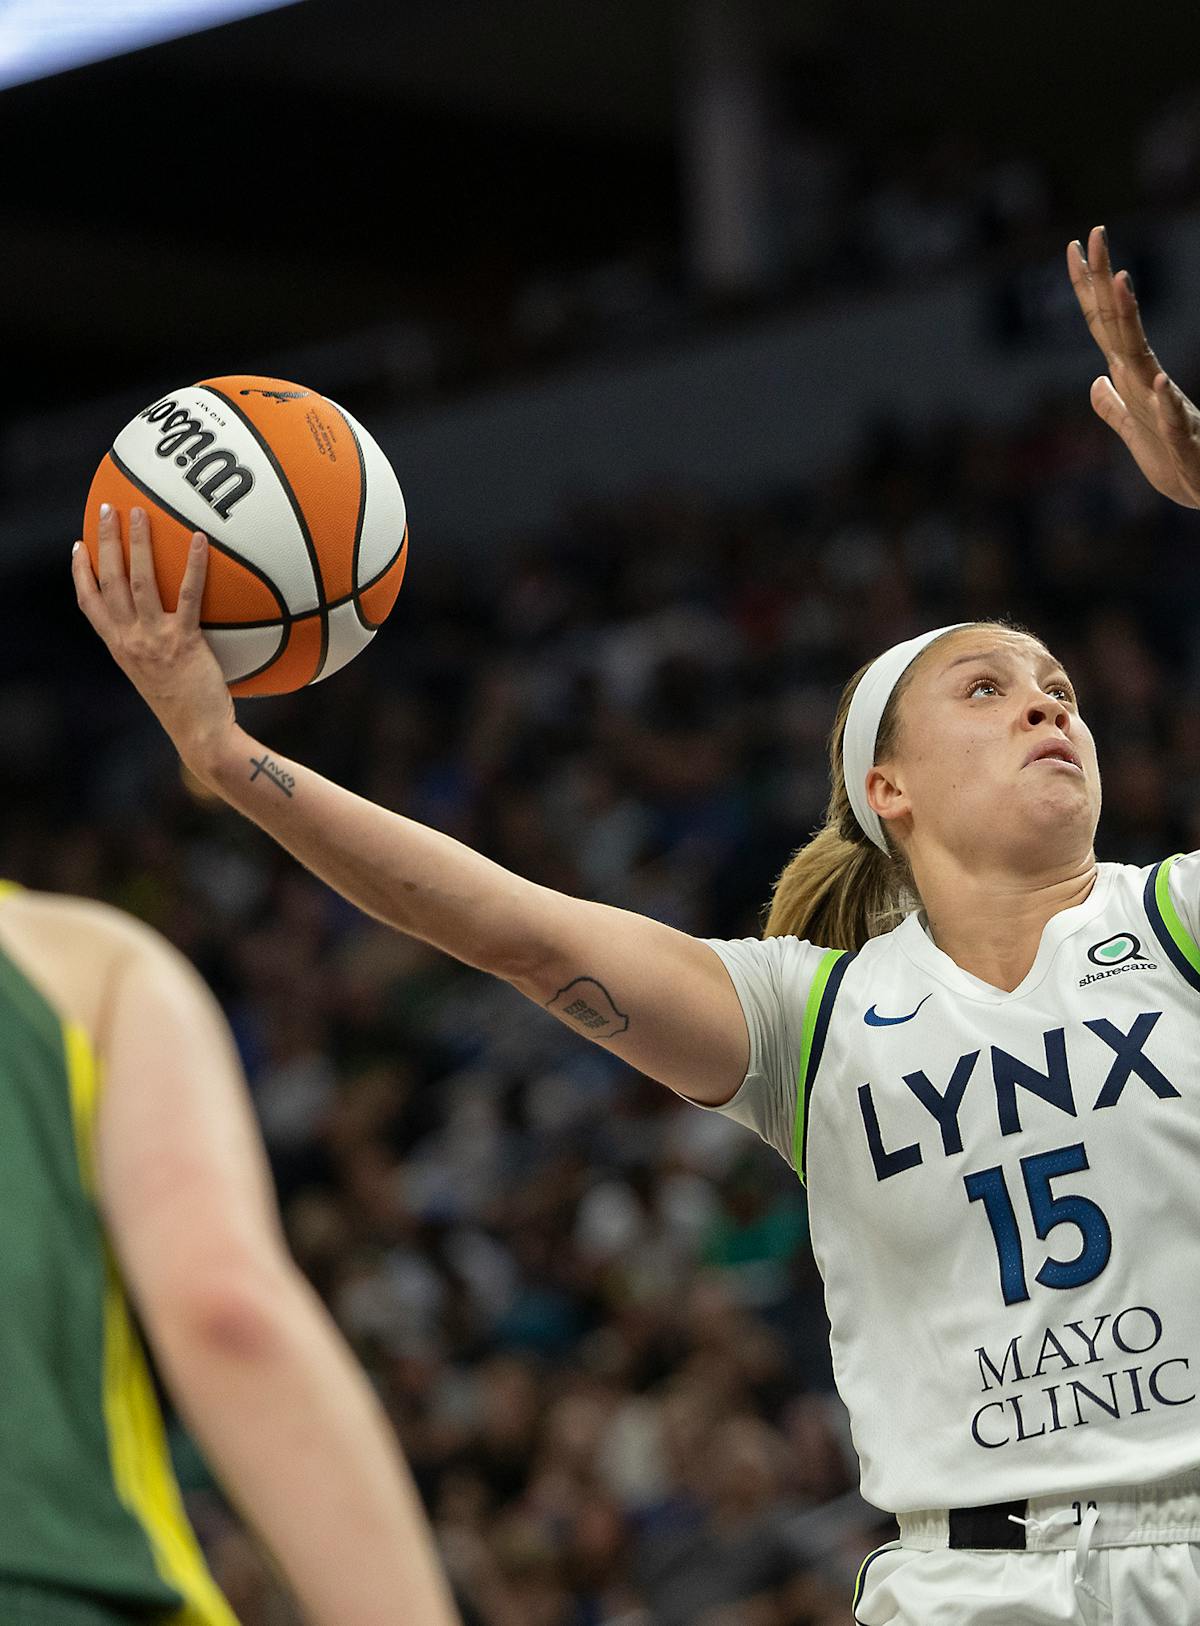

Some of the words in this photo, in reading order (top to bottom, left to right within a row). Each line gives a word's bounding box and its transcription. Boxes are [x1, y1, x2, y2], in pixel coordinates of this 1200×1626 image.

[1079, 963, 1158, 987] sharecare
[857, 1011, 1182, 1182] LYNX
[963, 1142, 1112, 1307] 15
[974, 1306, 1164, 1392] MAYO
[970, 1358, 1197, 1449] CLINIC
